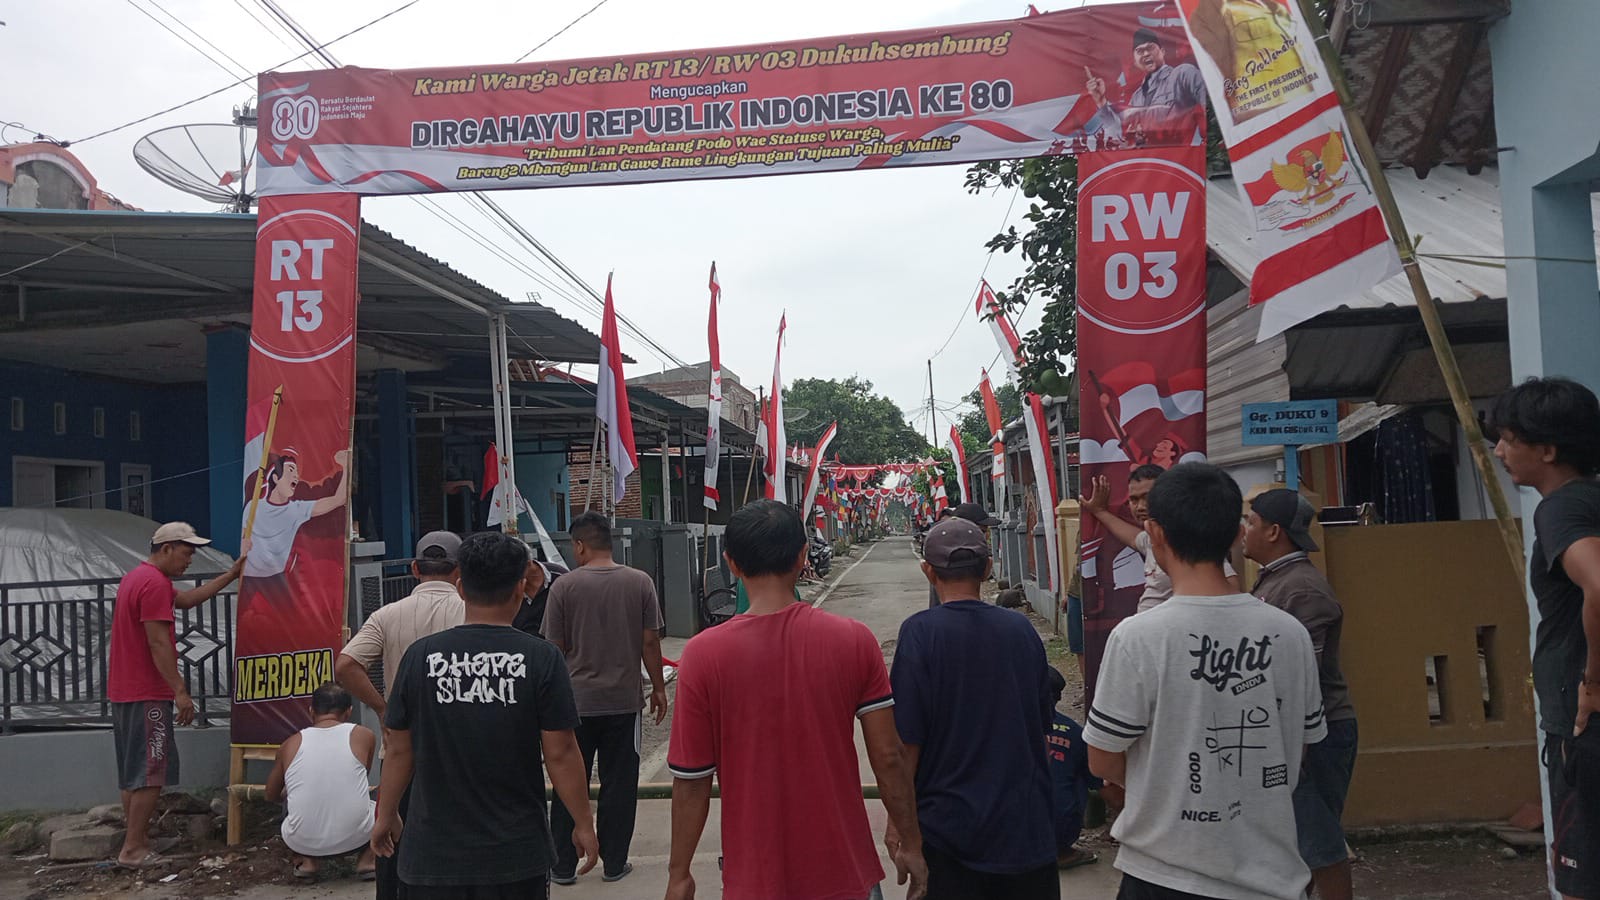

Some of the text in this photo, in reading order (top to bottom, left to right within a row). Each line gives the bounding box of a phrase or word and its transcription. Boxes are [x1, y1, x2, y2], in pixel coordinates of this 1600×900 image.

[412, 73, 477, 96] Kami
[481, 69, 559, 92] Warga
[562, 63, 629, 86] Jetak
[632, 60, 669, 81] RT
[712, 52, 760, 75] RW
[762, 49, 797, 70] 03
[799, 31, 1012, 67] Dukuhsembung
[1235, 66, 1306, 102] THE FIRST PRESIDENT
[320, 97, 345, 105] Bersatu
[650, 81, 747, 100] Mengucapkan
[1272, 89, 1281, 98] OF
[1282, 72, 1319, 94] INDONESIA
[271, 94, 320, 141] 80
[320, 104, 373, 113] Rakyat Sejahtera
[320, 111, 366, 120] Indonesia Maju
[411, 79, 1014, 149] DIRGAHAYU REPUBLIK INDONESIA KE 80
[457, 165, 519, 180] Bareng2
[521, 162, 589, 178] Mbangun
[590, 160, 619, 173] Lan
[620, 158, 659, 171] Gawe
[661, 155, 703, 169] Rame
[704, 150, 794, 167] Lingkungan
[797, 146, 852, 162] Tujuan
[853, 142, 903, 158] Paling
[589, 145, 617, 158] Lan
[618, 140, 694, 156] Pendatang
[696, 133, 732, 150] Podo
[735, 134, 768, 148] Wae
[769, 130, 826, 146] Statuse
[829, 126, 885, 142] Warga,
[1091, 191, 1191, 242] RW
[270, 239, 334, 280] RT
[1104, 251, 1178, 300] 03
[276, 290, 323, 332] 13
[1249, 411, 1272, 422] Gg.
[1275, 409, 1316, 420] DUKU
[236, 648, 334, 702] MERDEKA
[1189, 634, 1273, 692] Light
[1189, 752, 1202, 794] GOOD
